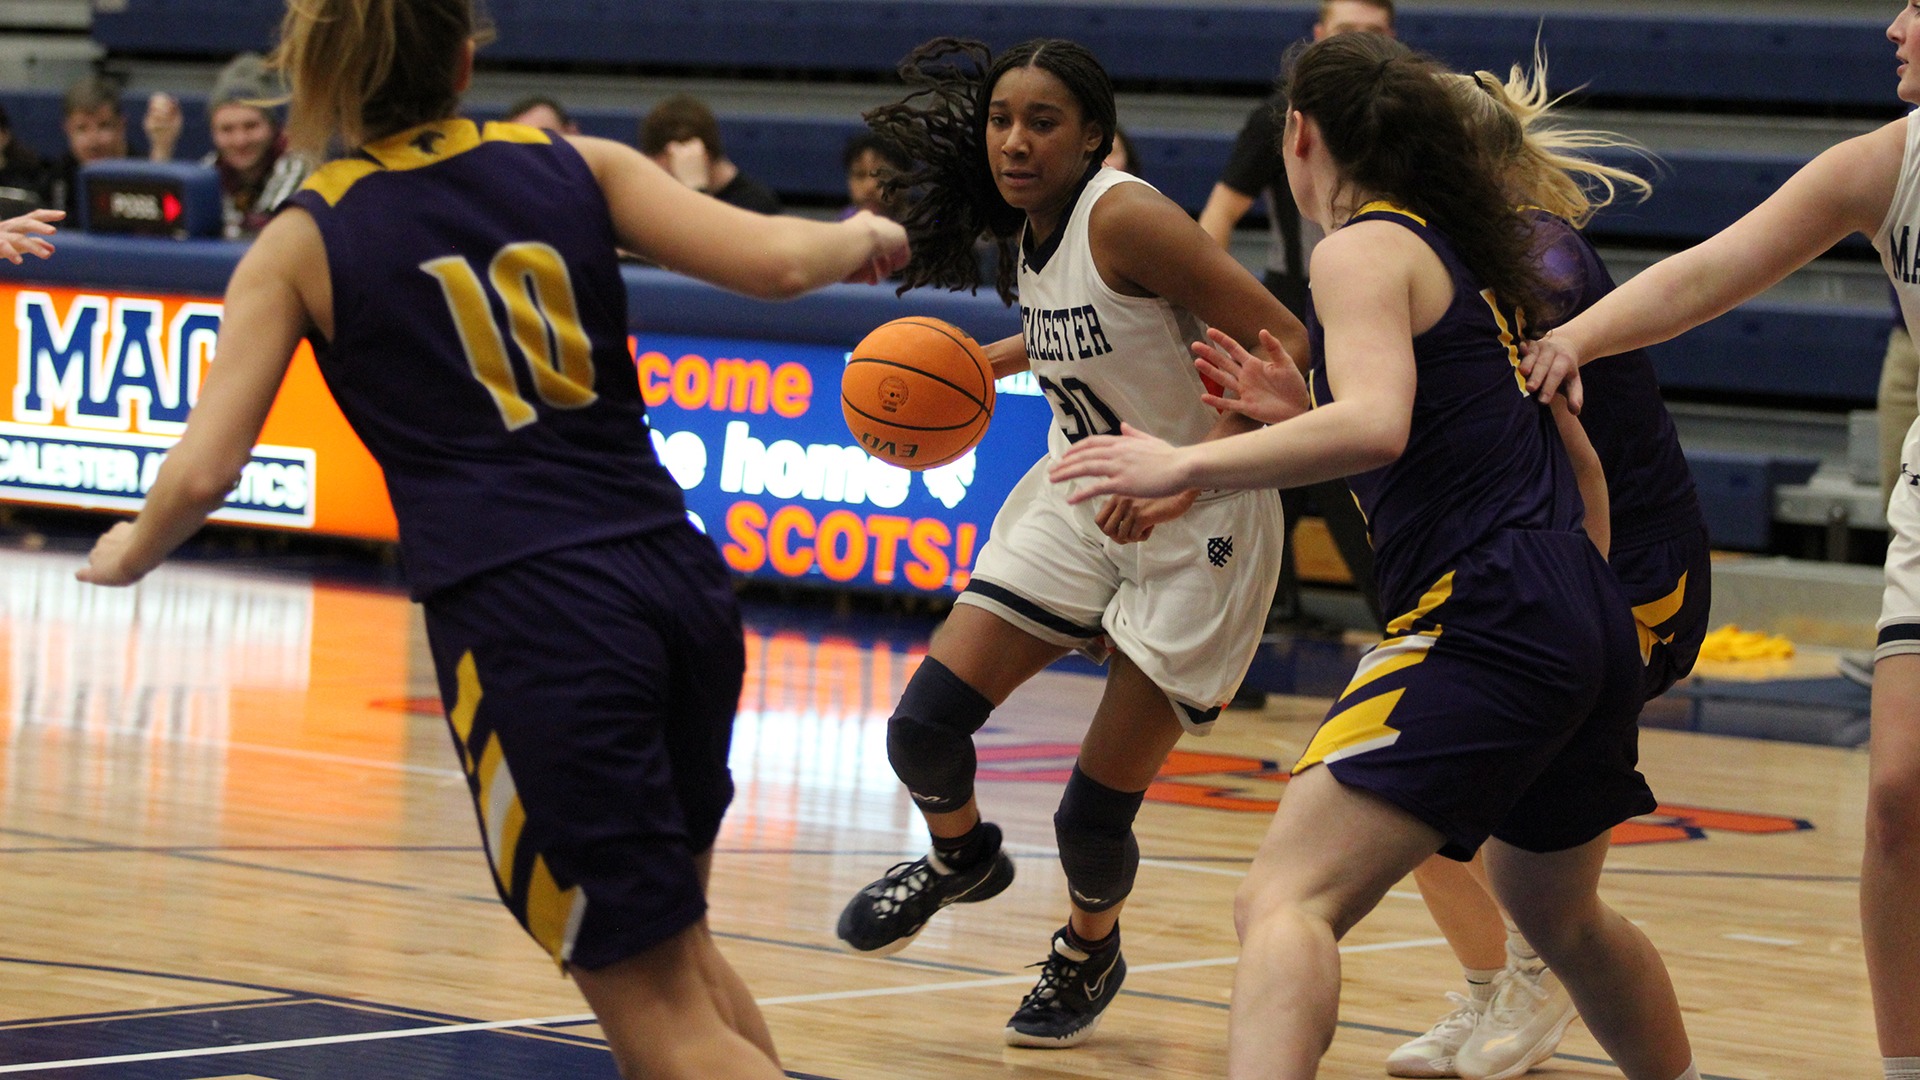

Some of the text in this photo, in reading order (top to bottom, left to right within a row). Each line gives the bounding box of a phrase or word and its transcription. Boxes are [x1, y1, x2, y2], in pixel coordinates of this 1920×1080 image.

[418, 241, 598, 432] 10
[1039, 375, 1123, 445] 30
[720, 420, 911, 508] home
[722, 501, 977, 592] SCOTS!
